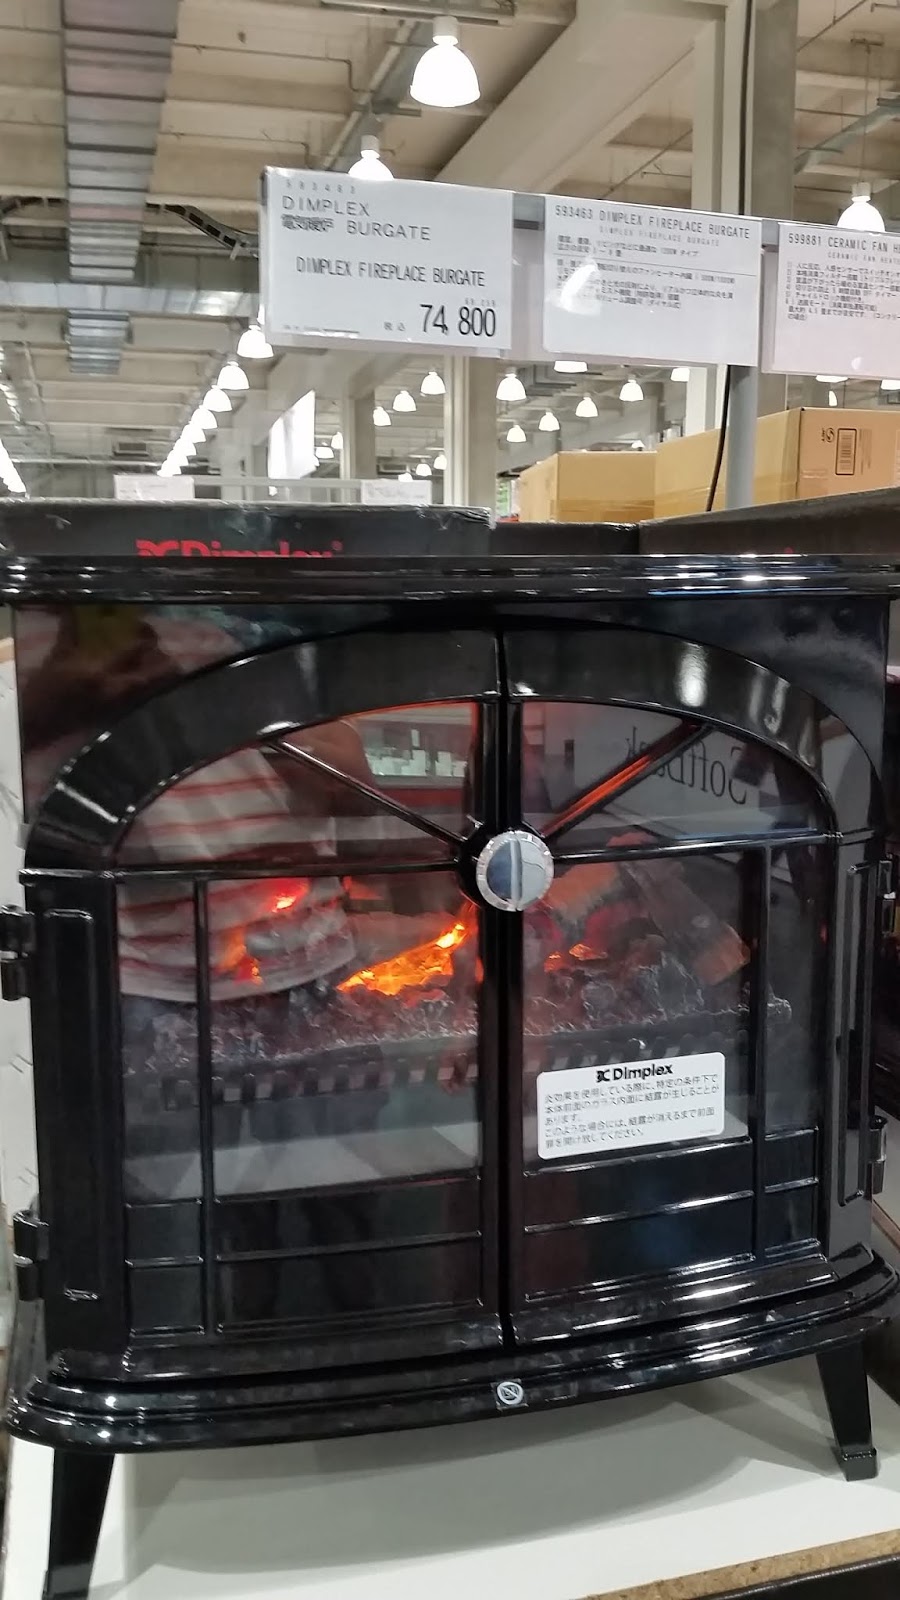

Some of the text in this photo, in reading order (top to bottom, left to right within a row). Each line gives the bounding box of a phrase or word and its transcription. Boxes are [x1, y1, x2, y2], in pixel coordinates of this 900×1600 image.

[282, 195, 371, 217] DIMPLEX
[347, 220, 432, 241] BURGATE
[555, 205, 750, 239] 593463 DIMPLEX FIREPLACE BURGATE
[788, 233, 822, 246] 599881
[828, 237, 867, 250] CERAMIC
[872, 242, 888, 252] FAN
[296, 256, 486, 288] DIMPLEX FIREPLACE BURGATE
[613, 1063, 673, 1080] Dimplex
